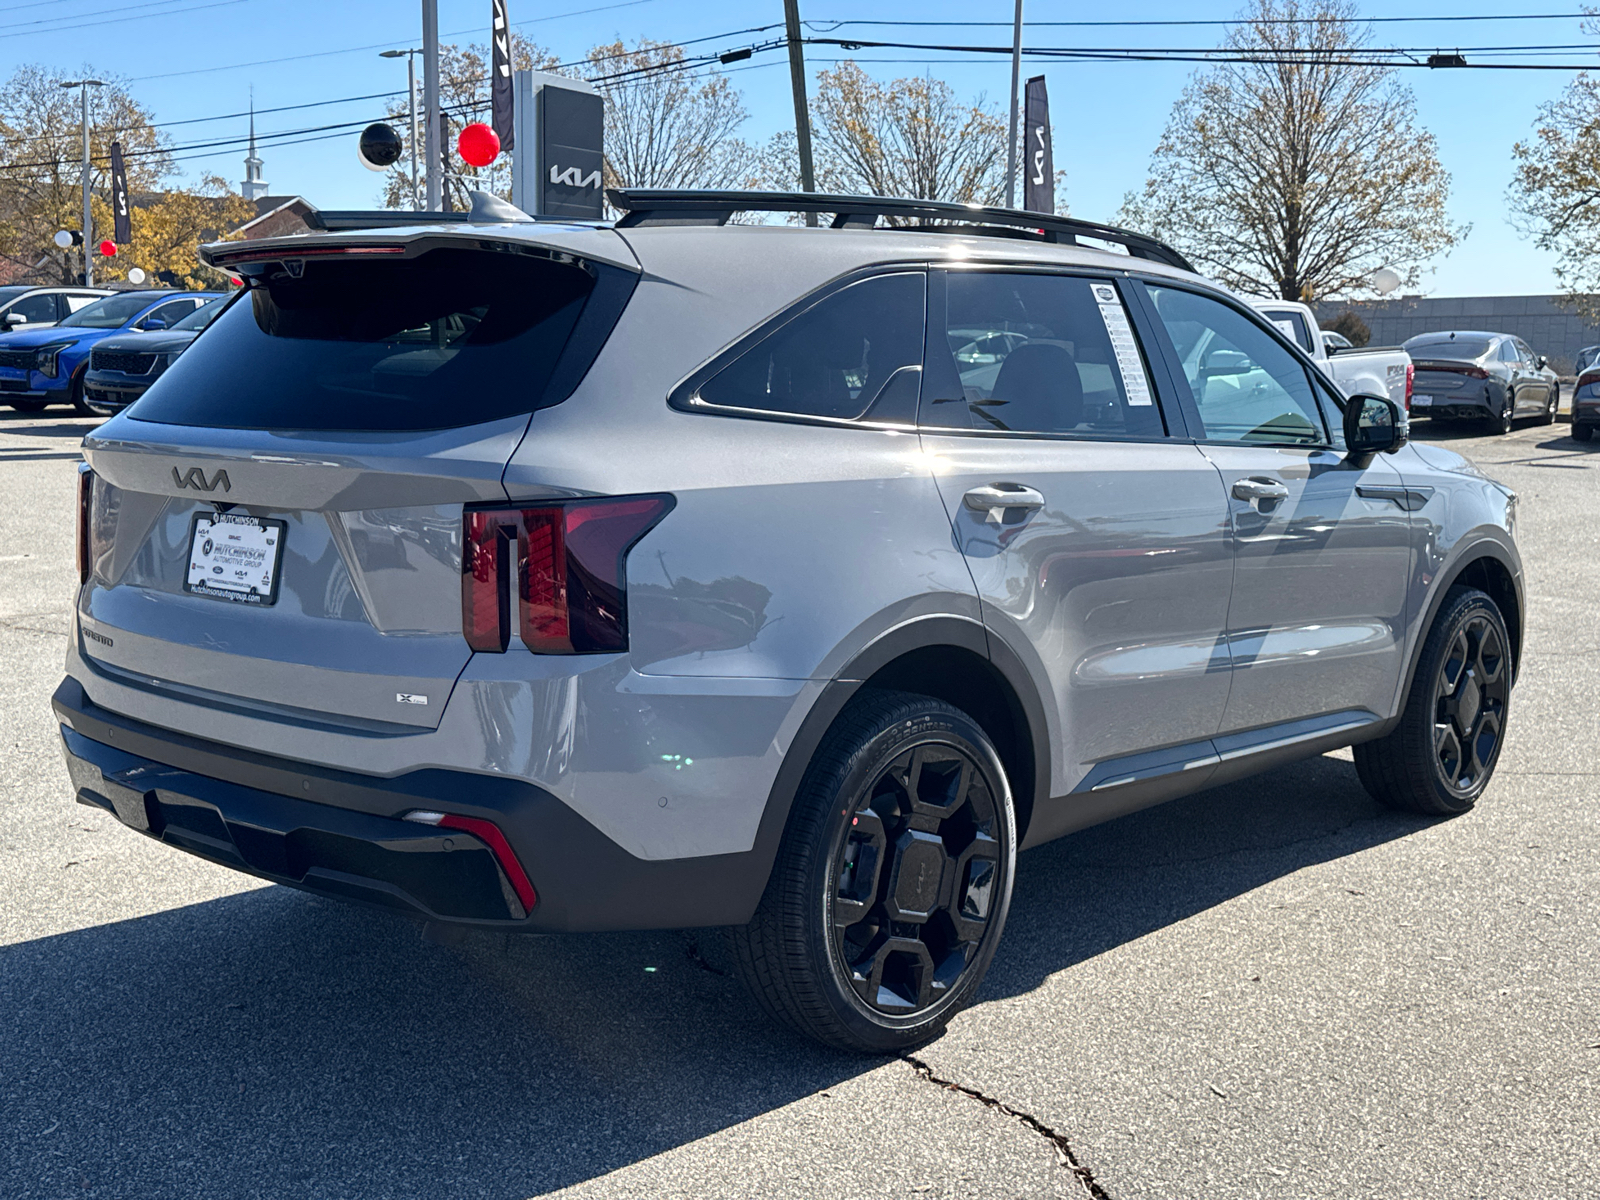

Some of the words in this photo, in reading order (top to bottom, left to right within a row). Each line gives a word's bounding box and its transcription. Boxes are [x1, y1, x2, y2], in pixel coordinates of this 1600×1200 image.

[550, 164, 602, 190] KIA
[1387, 364, 1405, 377] FX4
[171, 466, 232, 493] KIA
[220, 514, 260, 527] HUTCHINSON
[213, 543, 267, 561] HUTCHINSON
[213, 555, 244, 567] AUTOMOTIVE
[244, 559, 263, 569] GROUP
[190, 584, 261, 603] Hutchinsonautogroup.com
